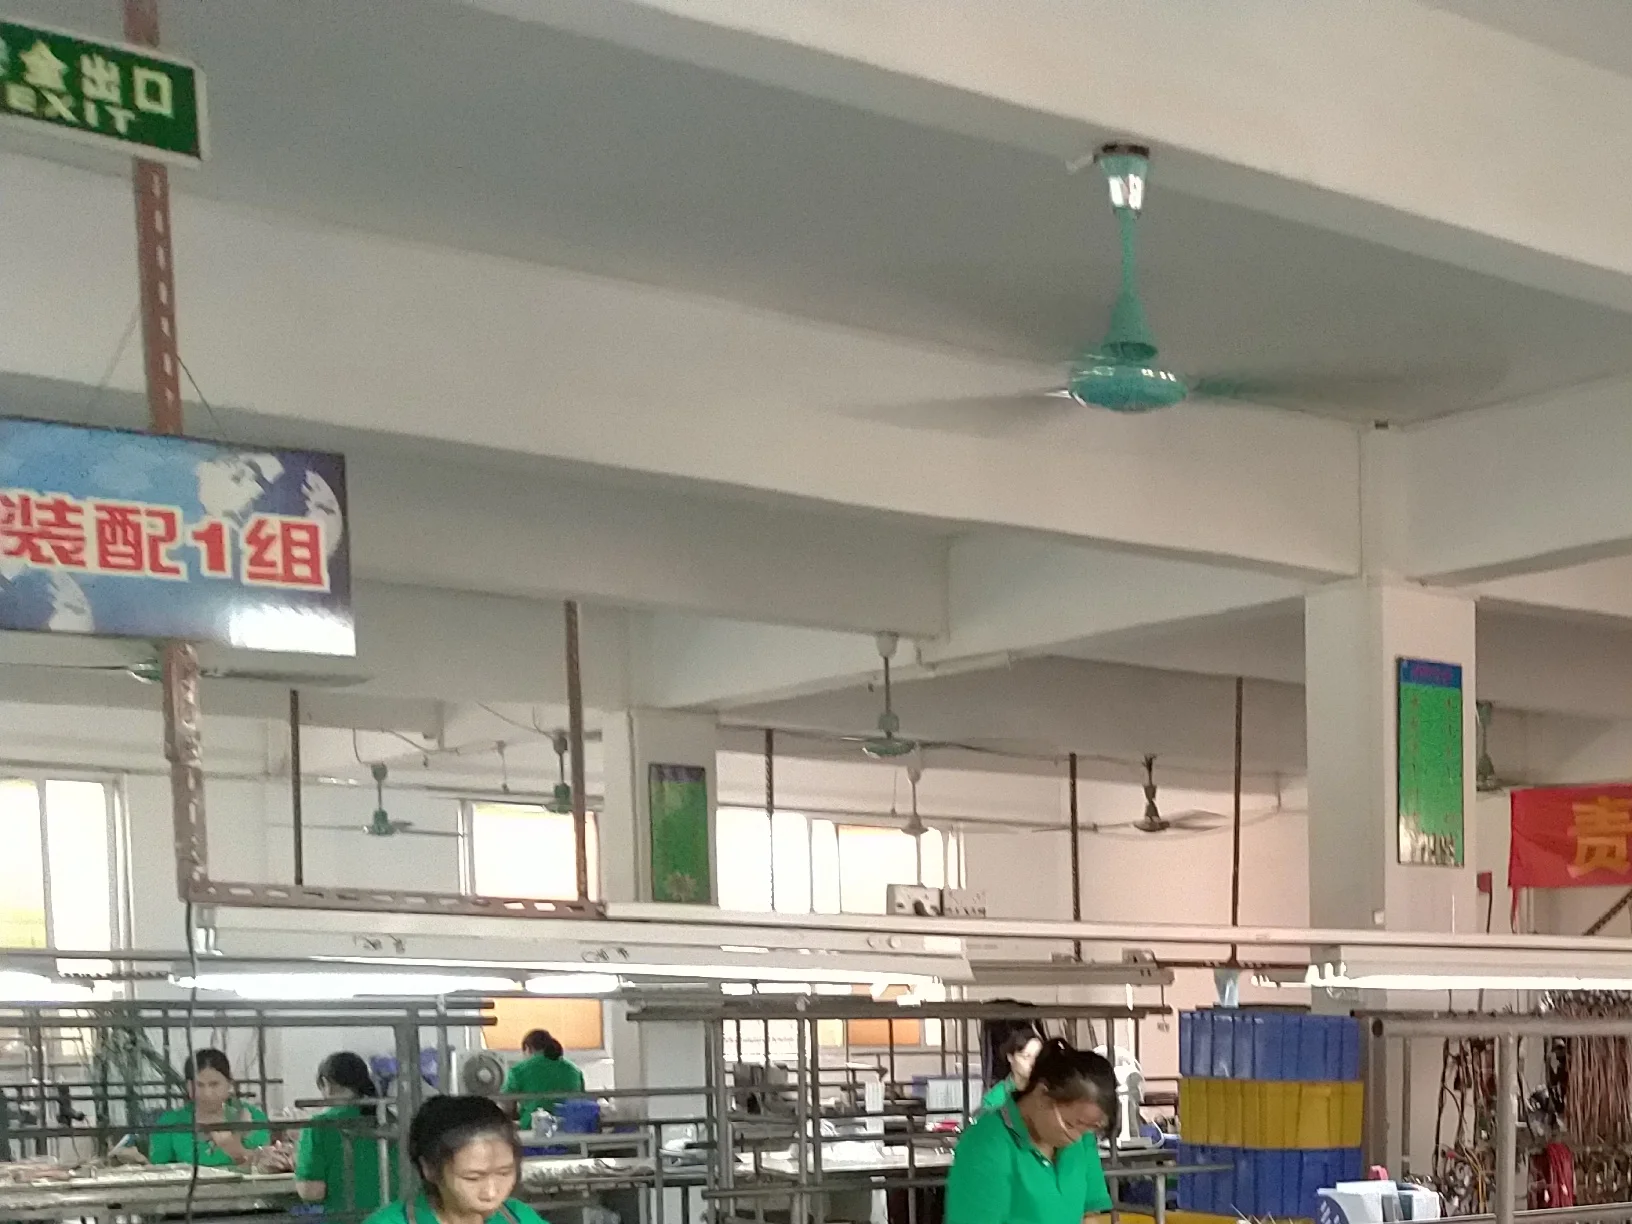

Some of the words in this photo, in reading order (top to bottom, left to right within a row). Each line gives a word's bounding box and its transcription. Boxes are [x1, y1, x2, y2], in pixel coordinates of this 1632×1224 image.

[0, 36, 174, 119] 全出口
[6, 82, 136, 135] EXIT
[0, 493, 326, 588] 装配1组
